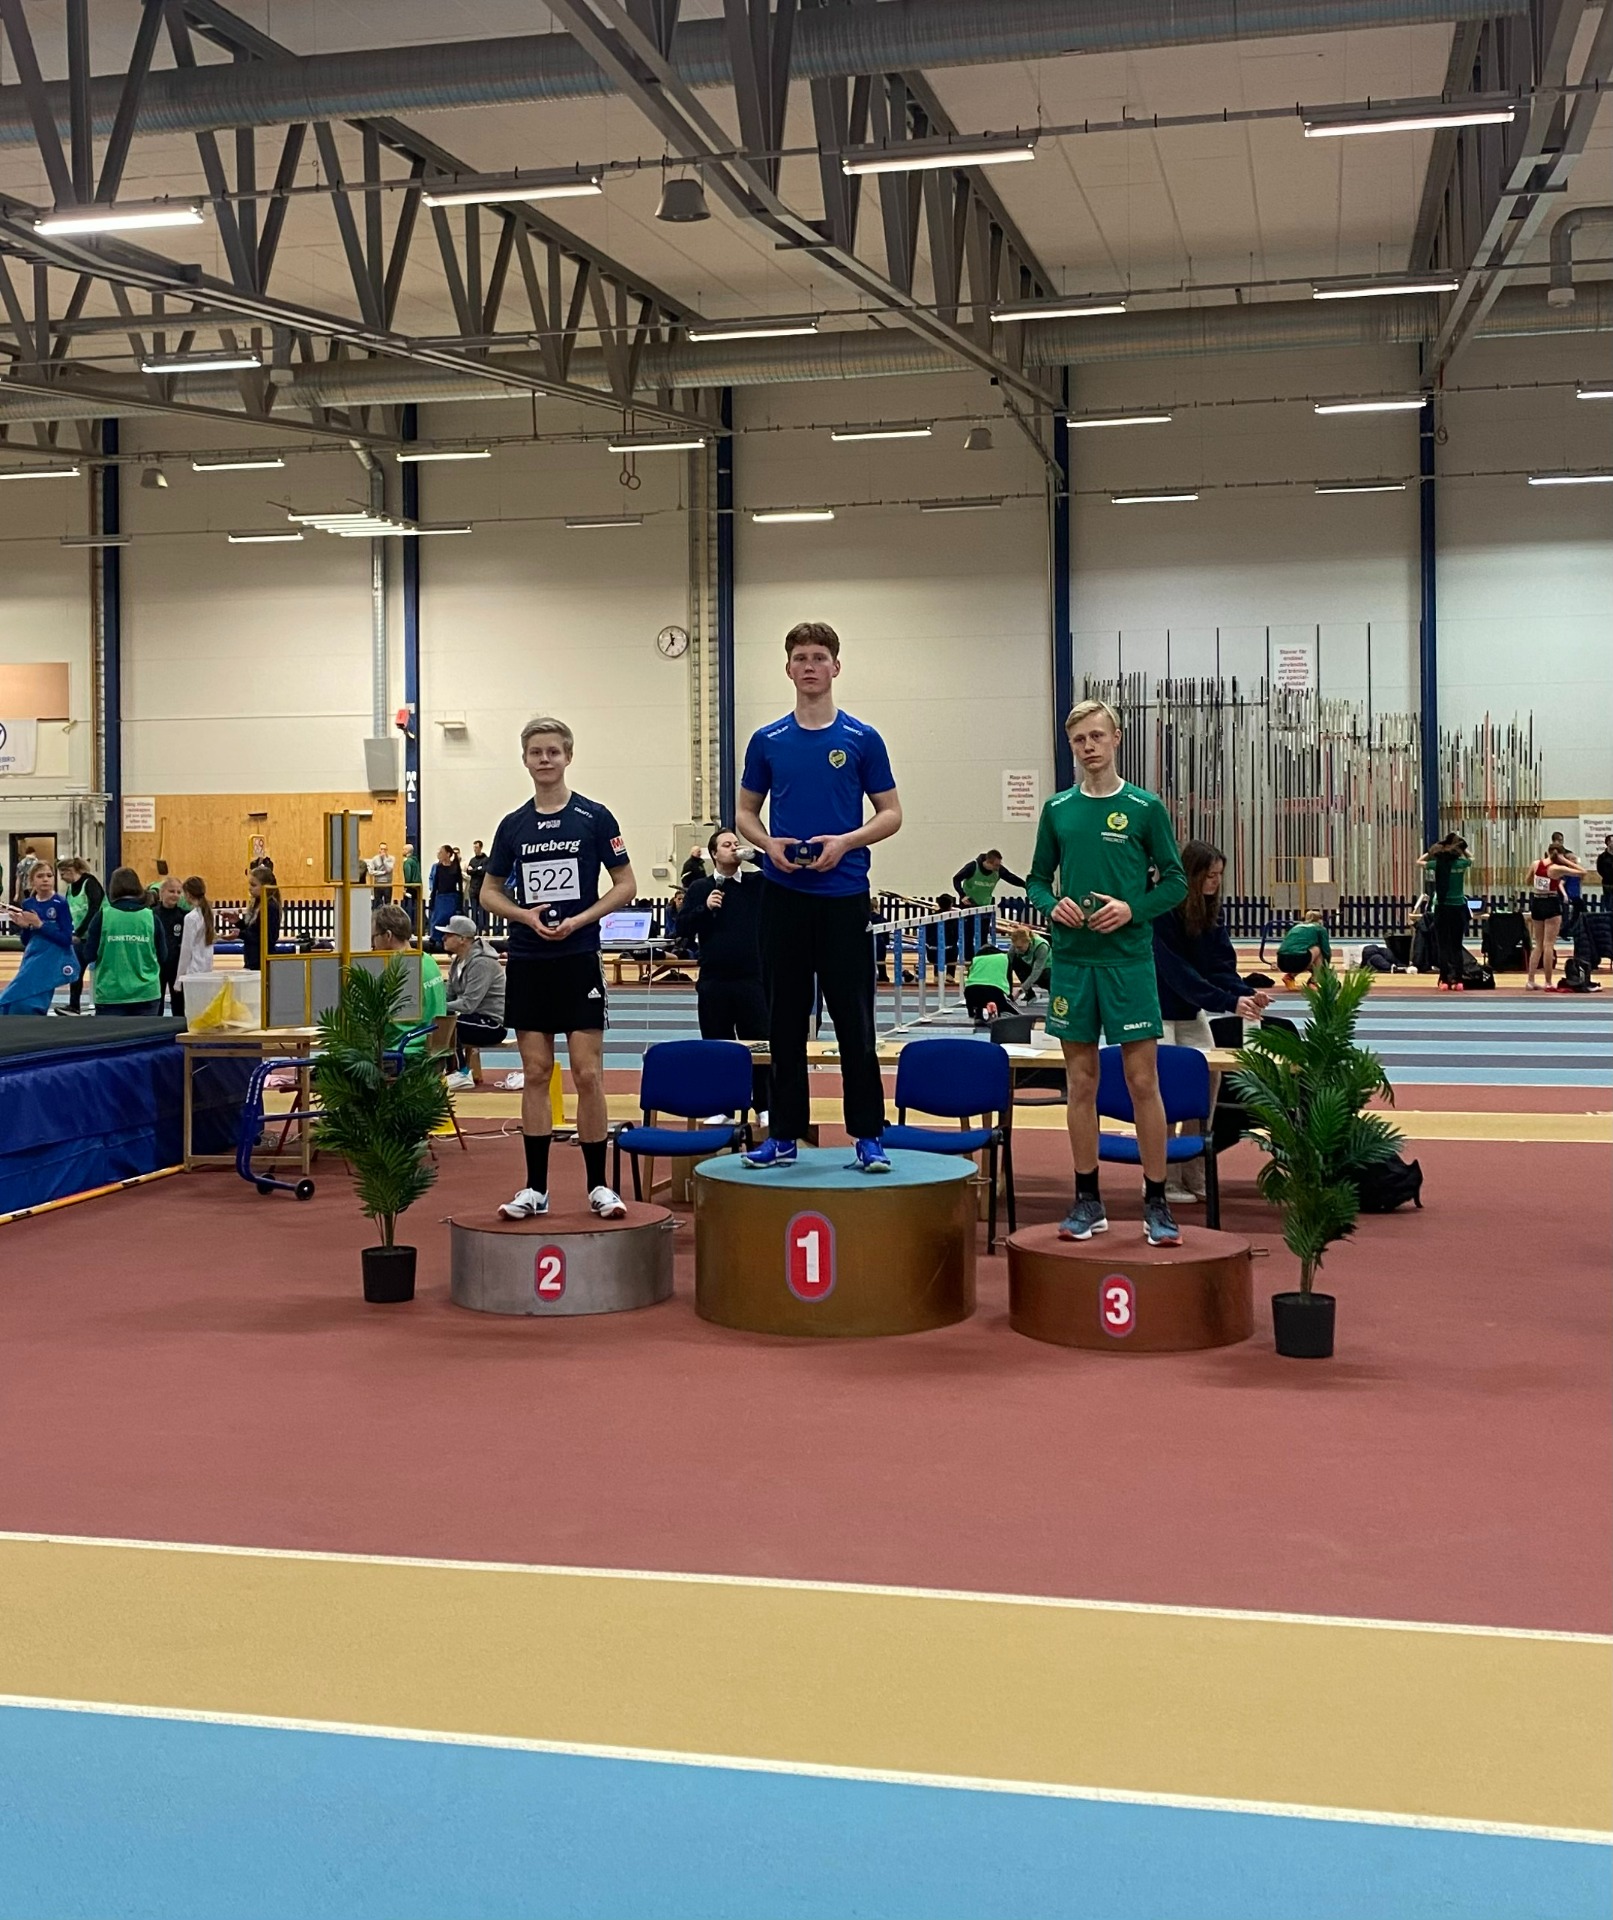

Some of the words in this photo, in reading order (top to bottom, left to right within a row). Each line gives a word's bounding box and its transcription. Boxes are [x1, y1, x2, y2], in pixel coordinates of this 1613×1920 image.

[521, 839, 581, 855] Tureberg
[528, 867, 574, 893] 522
[1123, 1021, 1148, 1030] CRAFT
[797, 1230, 820, 1283] 1
[539, 1256, 561, 1290] 2
[1105, 1287, 1130, 1325] 3
